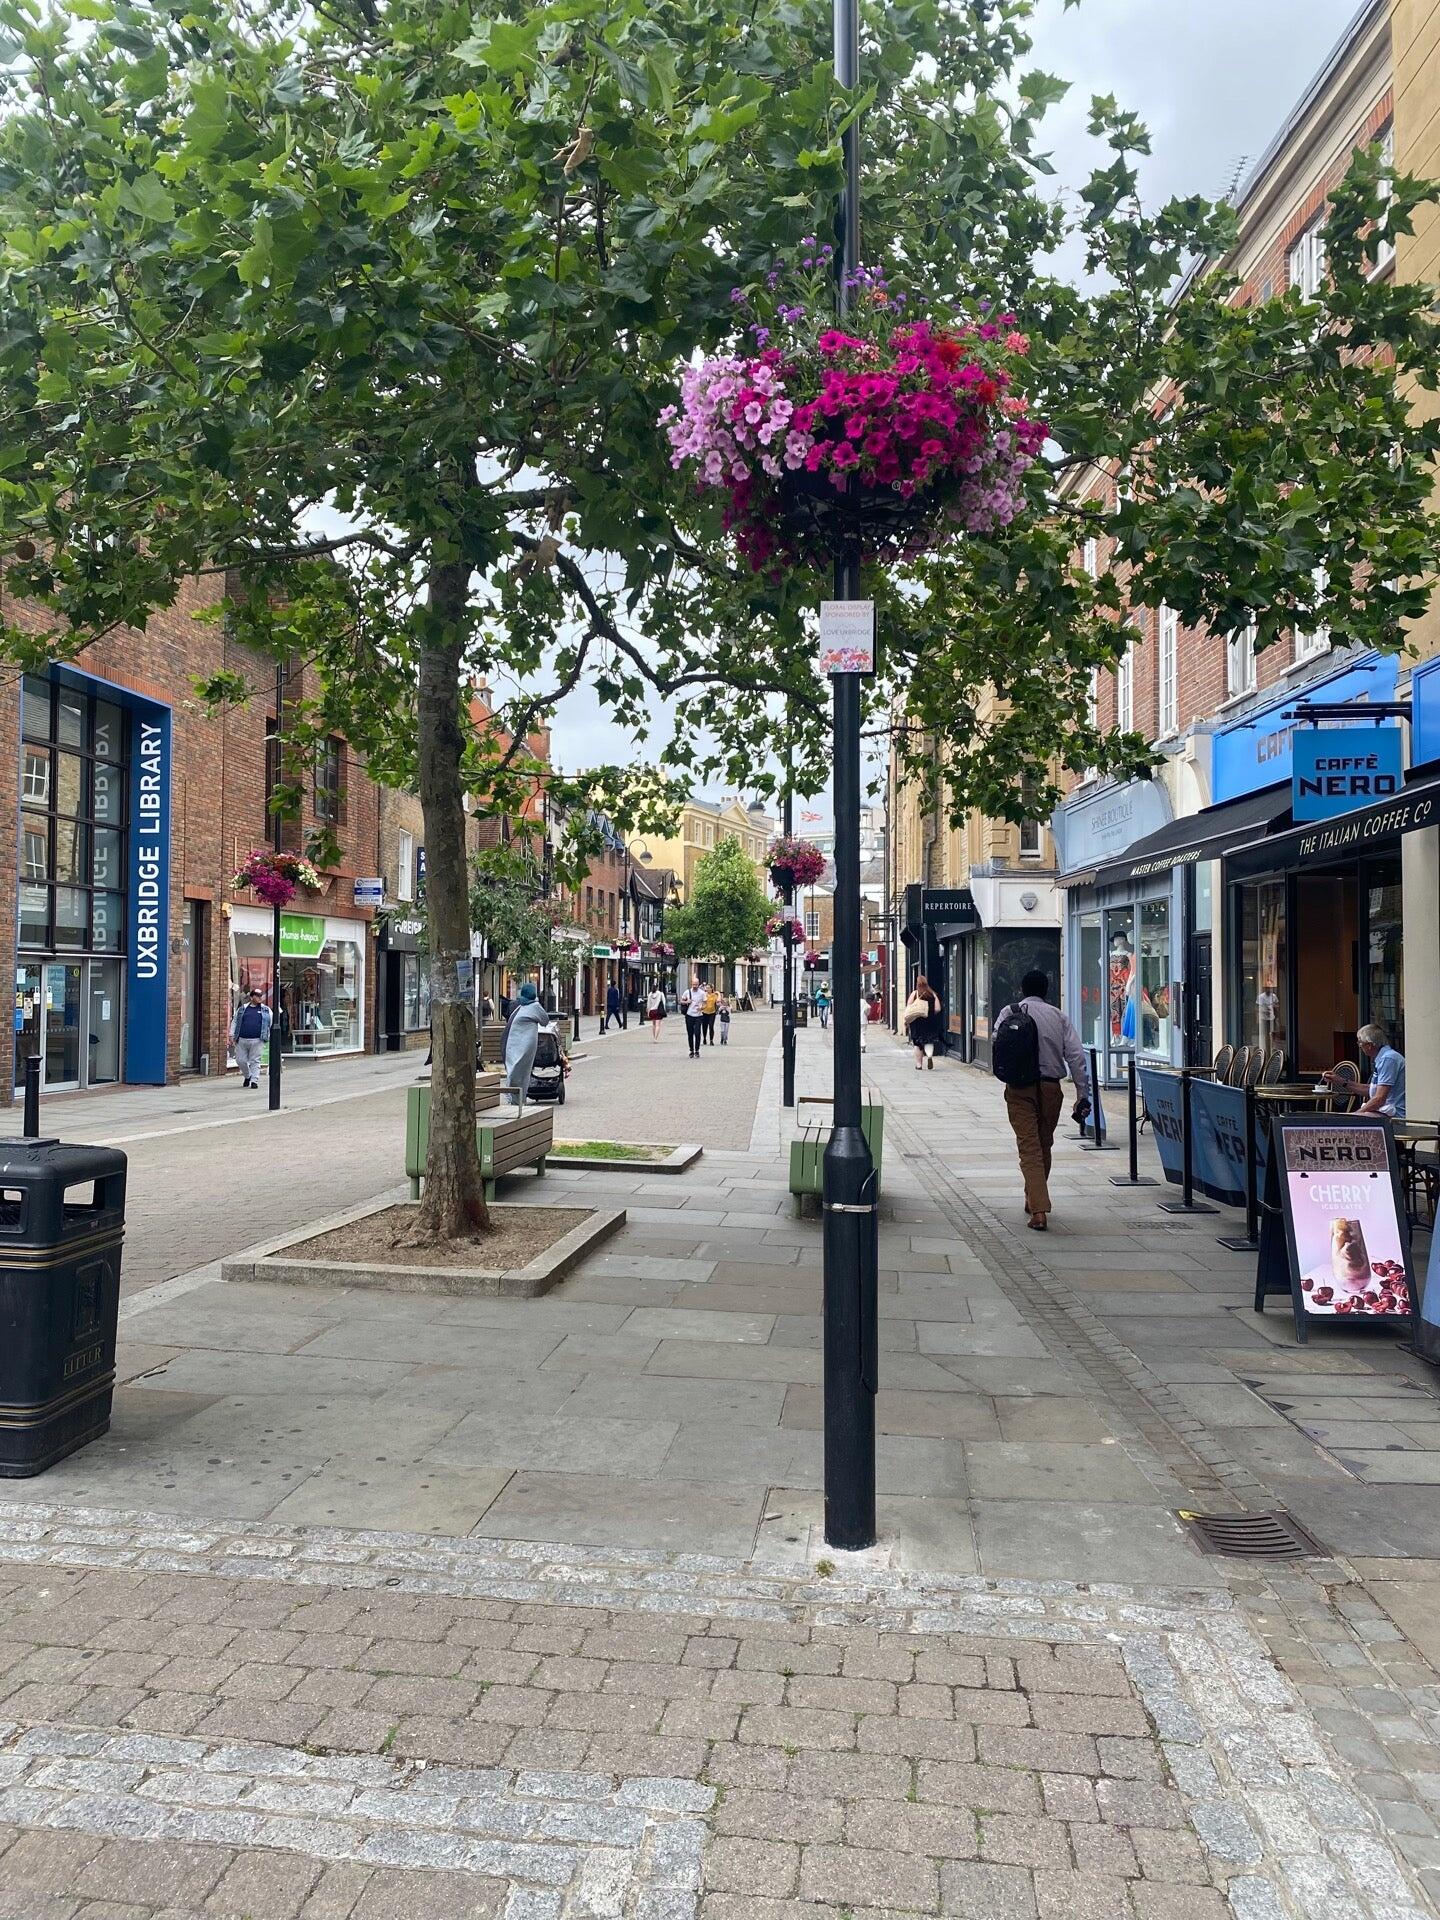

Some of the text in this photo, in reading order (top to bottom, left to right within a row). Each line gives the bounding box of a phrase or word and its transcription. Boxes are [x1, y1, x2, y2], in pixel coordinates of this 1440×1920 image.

[1300, 774, 1396, 797] NERO
[1300, 835, 1315, 855] THE
[1319, 823, 1360, 850] ITALIAN
[1364, 807, 1410, 837] COFFEE
[137, 722, 162, 979] UXBRIDGE LIBRARY
[1130, 850, 1202, 876] MASTER COFFEE ROASTERS
[925, 902, 972, 910] REPERTOIRE
[1150, 1112, 1183, 1144] NER
[1300, 1146, 1372, 1161] NERO
[1309, 1184, 1372, 1203] CHERRY
[64, 1347, 101, 1376] LITTER
